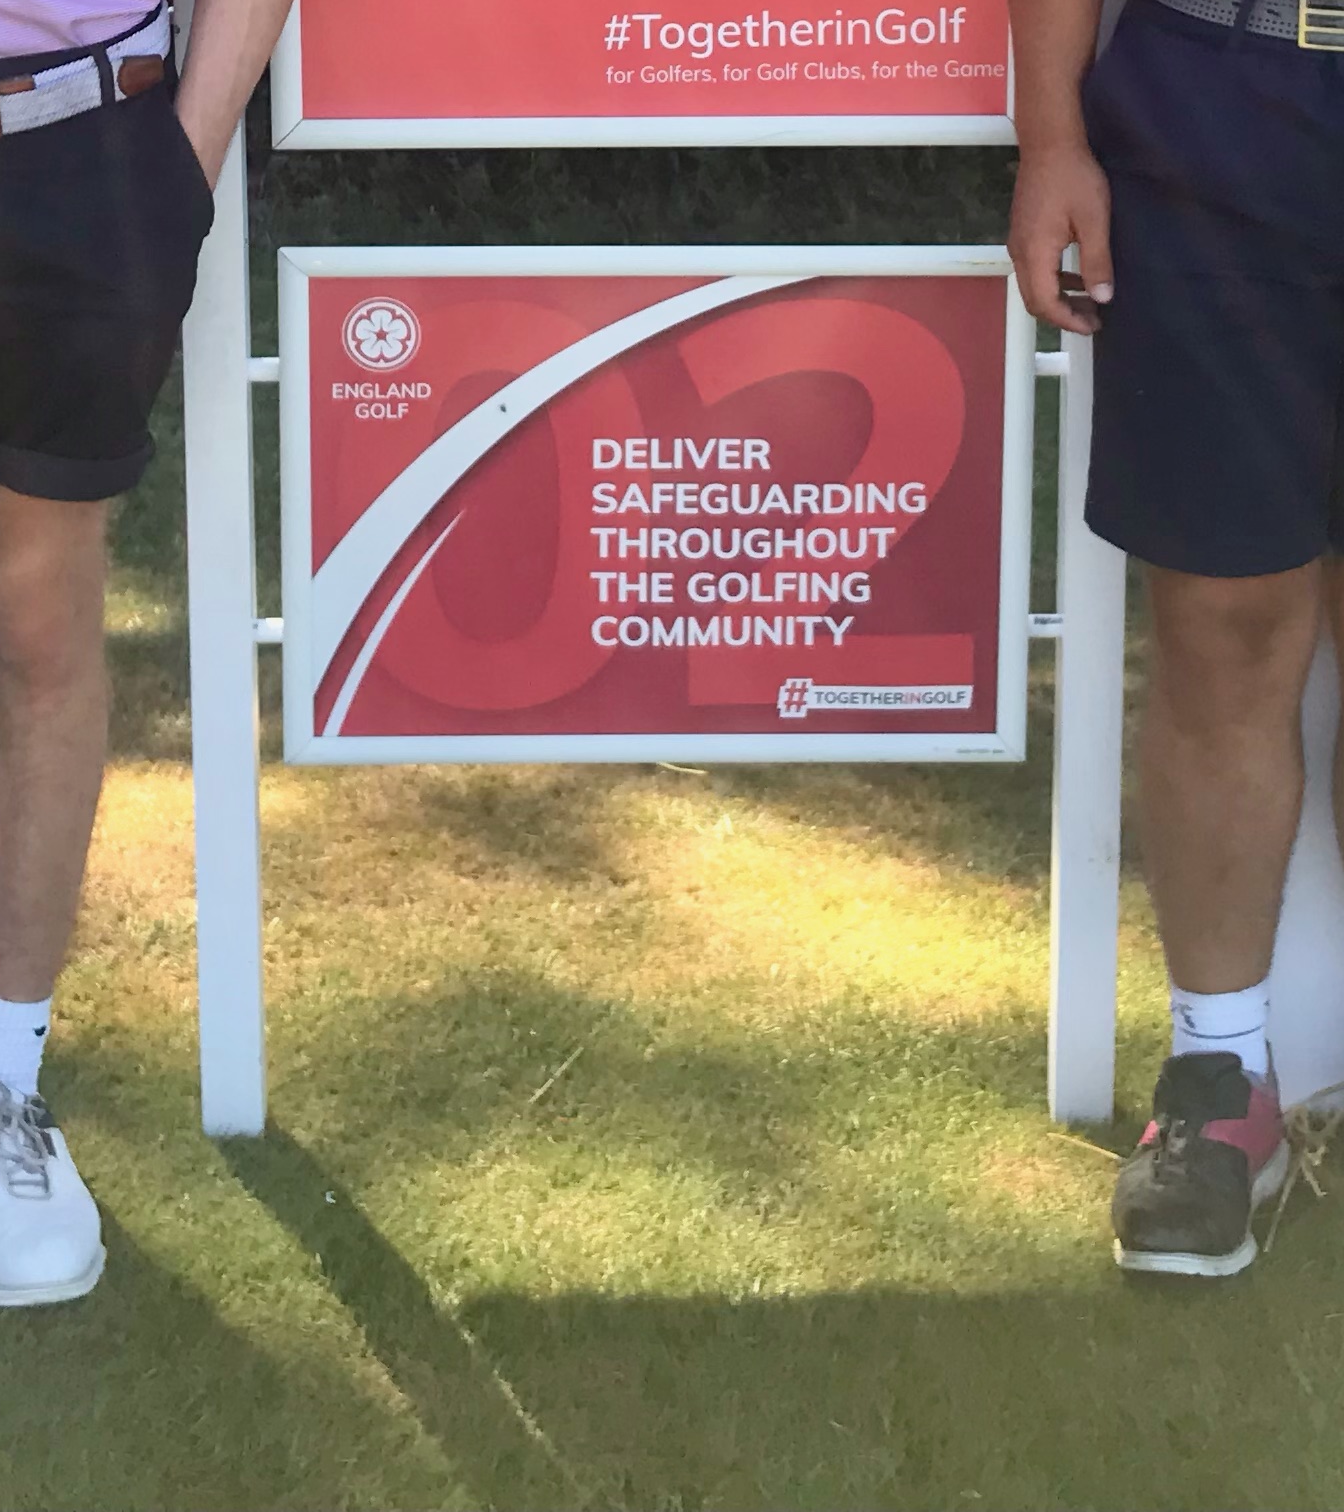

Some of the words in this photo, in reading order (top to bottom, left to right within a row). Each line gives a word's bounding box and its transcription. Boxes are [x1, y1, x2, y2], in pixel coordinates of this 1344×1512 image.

[604, 7, 966, 59] #TogetherinGolf
[606, 67, 633, 83] for
[640, 65, 717, 84] Golfers,
[722, 64, 752, 81] for
[757, 63, 798, 81] Golf
[803, 62, 866, 81] Clubs,
[871, 61, 900, 79] for
[905, 61, 938, 78] the
[944, 60, 1005, 78] Game
[332, 383, 432, 399] ENGLAND
[355, 402, 409, 419] GOLF
[592, 438, 771, 470] DELIVER
[592, 483, 927, 515] SAFEGUARDING
[591, 527, 896, 560] THROUGHOUT
[591, 571, 674, 603] THE
[687, 571, 871, 603] GOLFING
[591, 615, 855, 647] COMMUNITY
